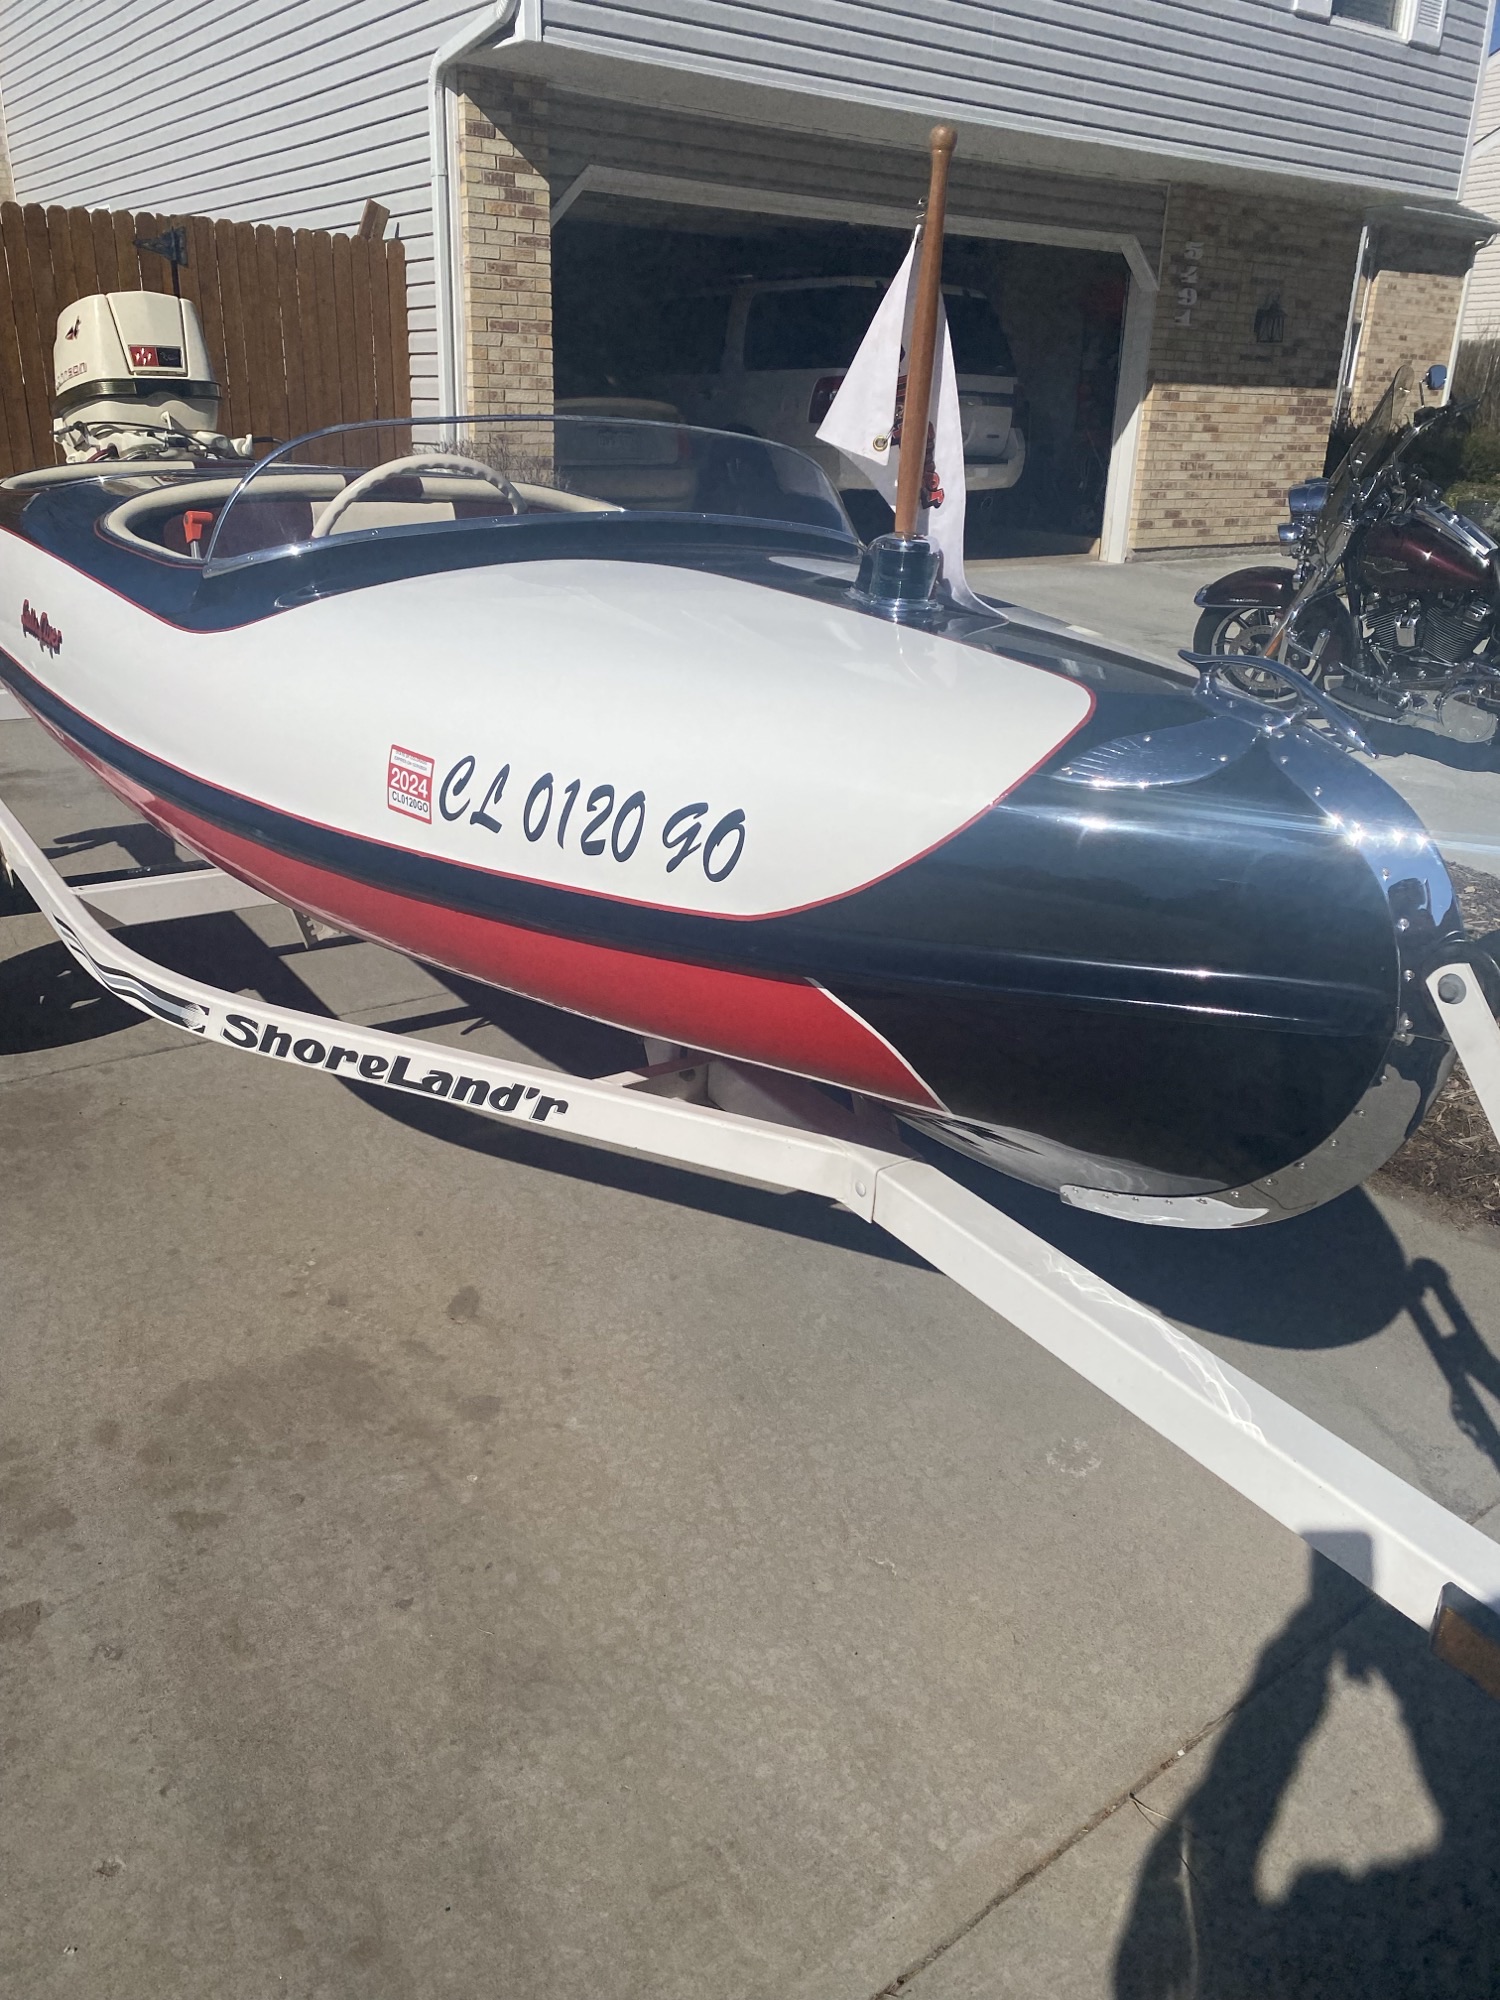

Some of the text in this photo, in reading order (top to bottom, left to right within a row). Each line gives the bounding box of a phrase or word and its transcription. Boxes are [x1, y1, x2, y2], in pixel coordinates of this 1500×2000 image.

[390, 767, 428, 798] 2024
[392, 791, 429, 813] CL0120GO
[439, 755, 510, 833] CL
[523, 772, 646, 862] 0120
[222, 1013, 569, 1122] ShoreLand'r
